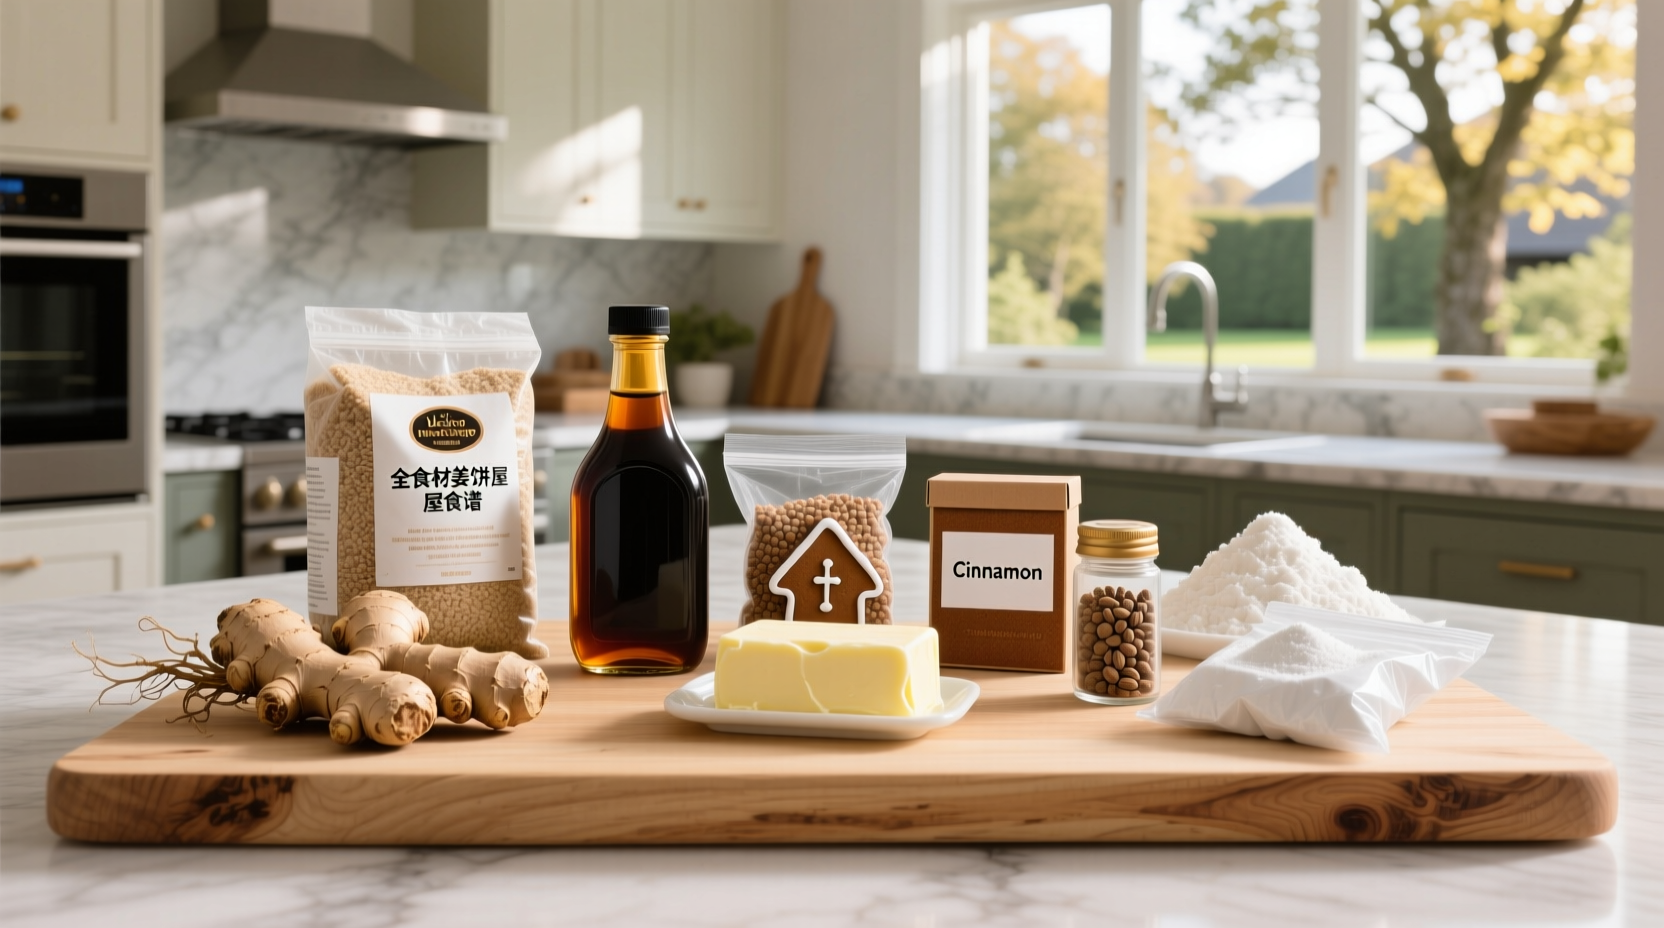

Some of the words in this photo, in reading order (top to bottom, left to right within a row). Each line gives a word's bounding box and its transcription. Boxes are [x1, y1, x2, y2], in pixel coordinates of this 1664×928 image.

[391, 465, 508, 489] 全食材姜饼屋
[423, 490, 483, 513] 屋食谱
[953, 561, 1043, 580] Cinnamon
